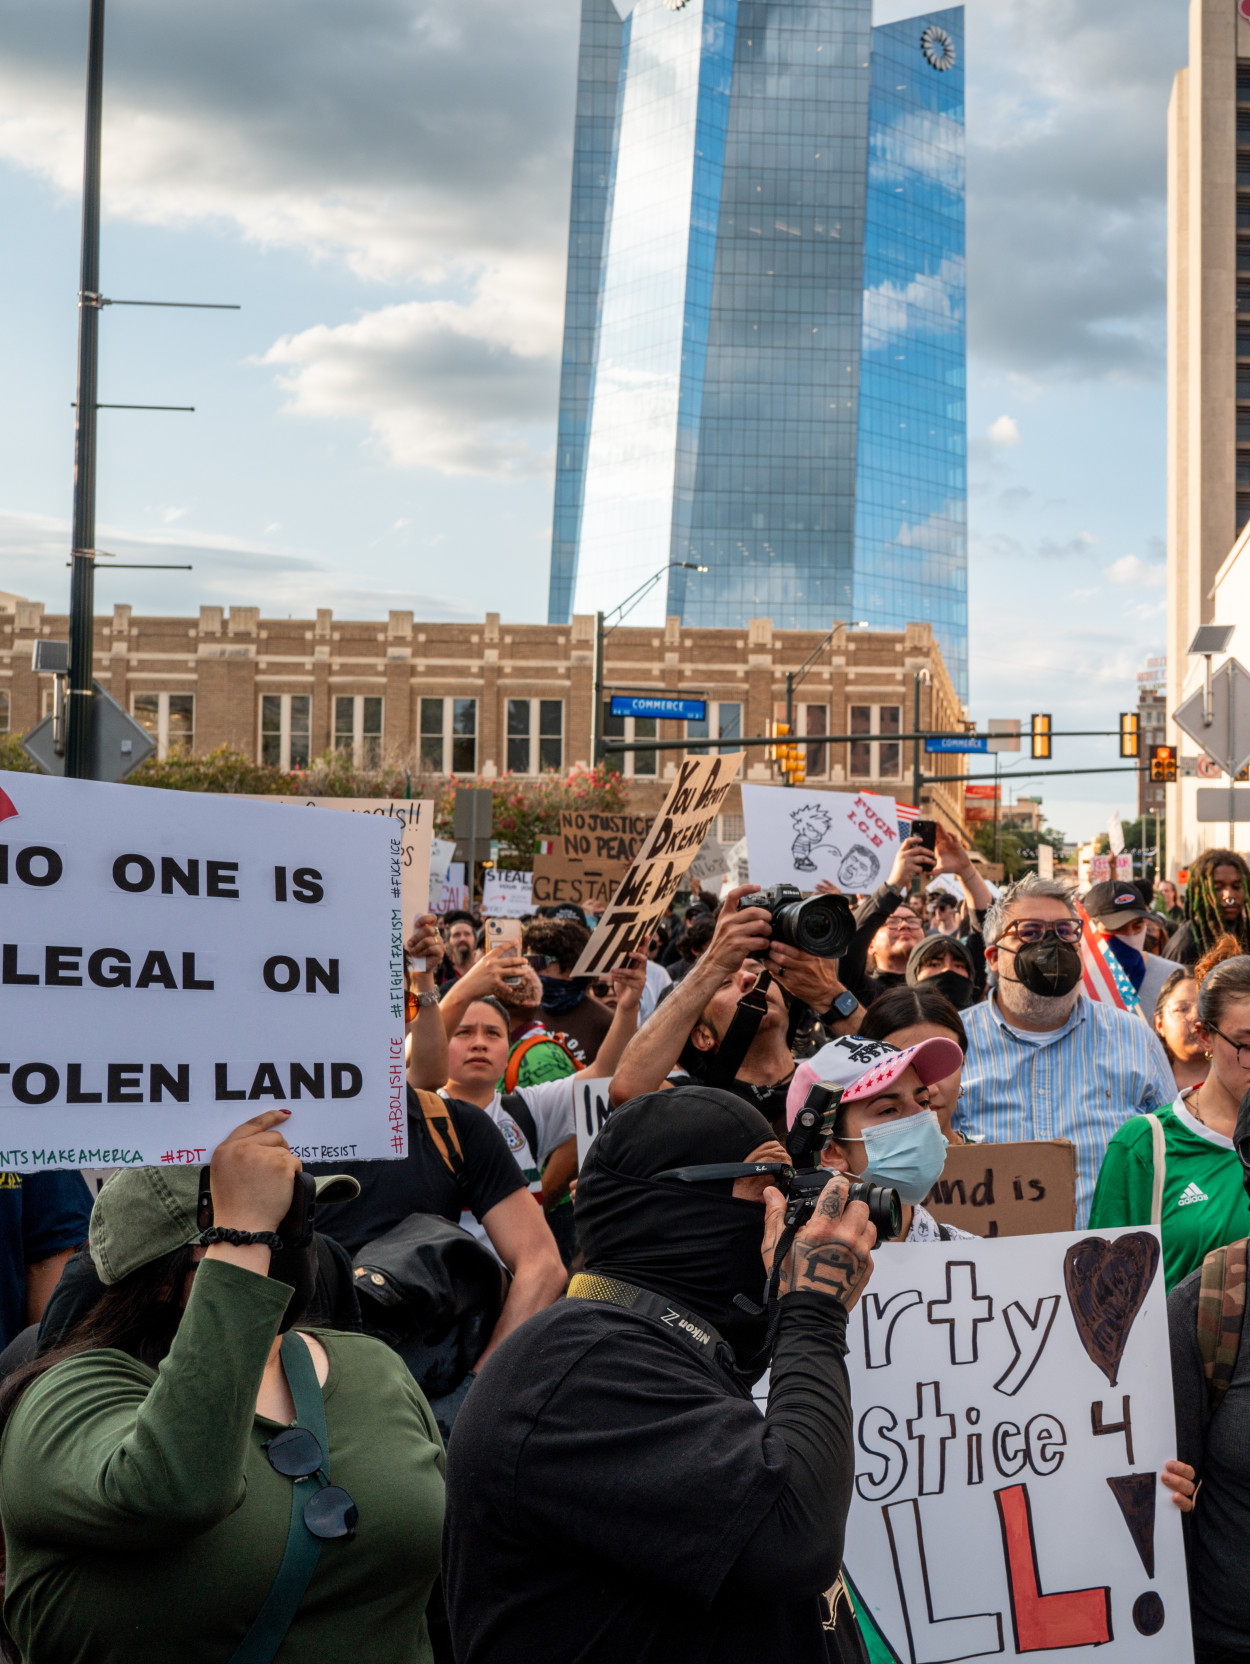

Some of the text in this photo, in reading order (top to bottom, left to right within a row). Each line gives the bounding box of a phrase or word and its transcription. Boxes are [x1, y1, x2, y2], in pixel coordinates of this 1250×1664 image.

[632, 699, 684, 712] COMMERCE
[941, 739, 982, 748] COMMERCE
[562, 812, 585, 830] NO
[853, 796, 897, 841] FUCK
[564, 834, 591, 855] NO
[112, 853, 240, 899] ONE
[274, 865, 325, 904] IS
[391, 838, 402, 898] #FUCK ICE
[533, 876, 621, 902] GESTAP
[613, 863, 655, 906] WE
[2, 944, 341, 995] LEGAL ON
[389, 1037, 403, 1060] ICE
[214, 1062, 363, 1101] LAND
[32, 1149, 77, 1165] MAKE
[78, 1149, 144, 1164] AMERICA
[160, 1148, 206, 1164] #FDT
[321, 1144, 357, 1158] RESIST
[1012, 1175, 1047, 1202] is
[1178, 1193, 1208, 1206] adidas
[660, 1307, 711, 1345] Nikon Z
[846, 1260, 1061, 1396] rty
[1091, 1395, 1135, 1465] 4
